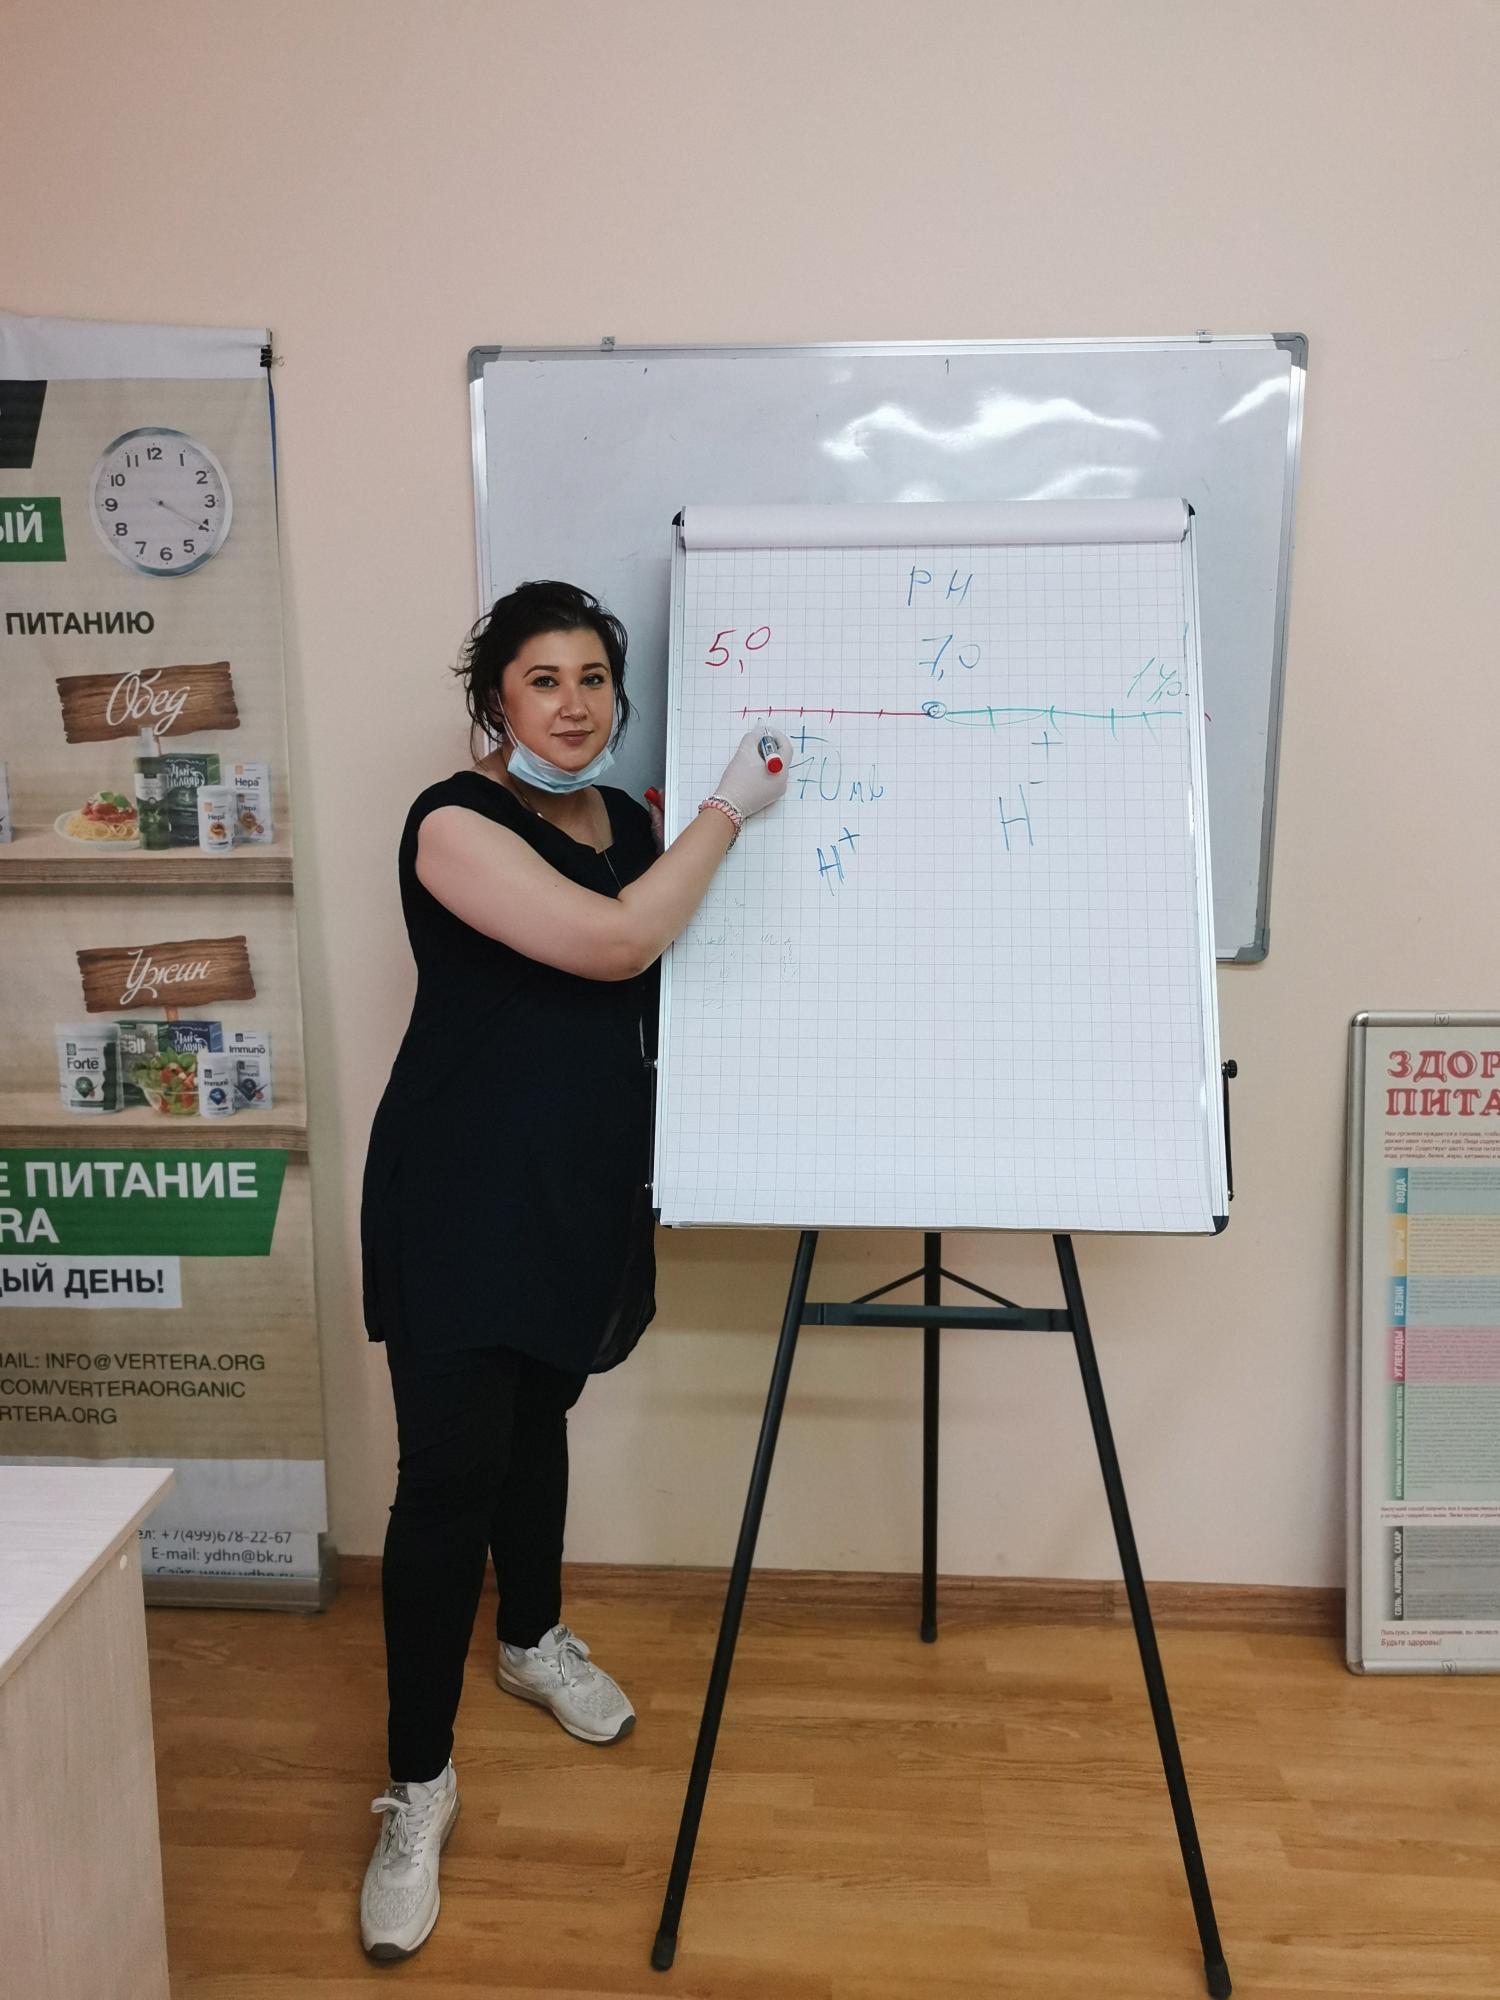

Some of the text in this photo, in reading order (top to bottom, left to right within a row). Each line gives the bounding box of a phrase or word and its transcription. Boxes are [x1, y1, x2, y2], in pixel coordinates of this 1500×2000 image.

[126, 454, 139, 468] 11
[147, 447, 162, 460] 12
[180, 453, 184, 467] 1
[110, 473, 126, 487] 10
[195, 470, 208, 485] 2
[105, 498, 118, 512] 9
[204, 494, 216, 508] 3
[115, 522, 128, 536] 8
[135, 541, 147, 555] 7
[160, 547, 173, 561] 6
[183, 539, 195, 553] 5
[6, 611, 155, 635] ПИТАНИЮ
[704, 626, 771, 674] 5,0
[919, 634, 981, 681] 7,0
[106, 670, 191, 735] Обед
[235, 777, 259, 788] Hepa
[120, 949, 211, 1005] Ужин
[67, 1057, 99, 1070] Forte
[1387, 1050, 1500, 1083] ЗДОР
[1385, 1088, 1500, 1116] ПИТА
[25, 1162, 258, 1198] ПИТАНИЕ
[0, 1207, 60, 1244] RA
[64, 1269, 164, 1299] ДЕНЬ!
[1394, 1330, 1405, 1377] УГЛЕВОДЫ
[46, 1353, 265, 1371] INFO@VERTERA.ORG
[152, 1547, 293, 1564] E-mail: ydhn@bk.ru
